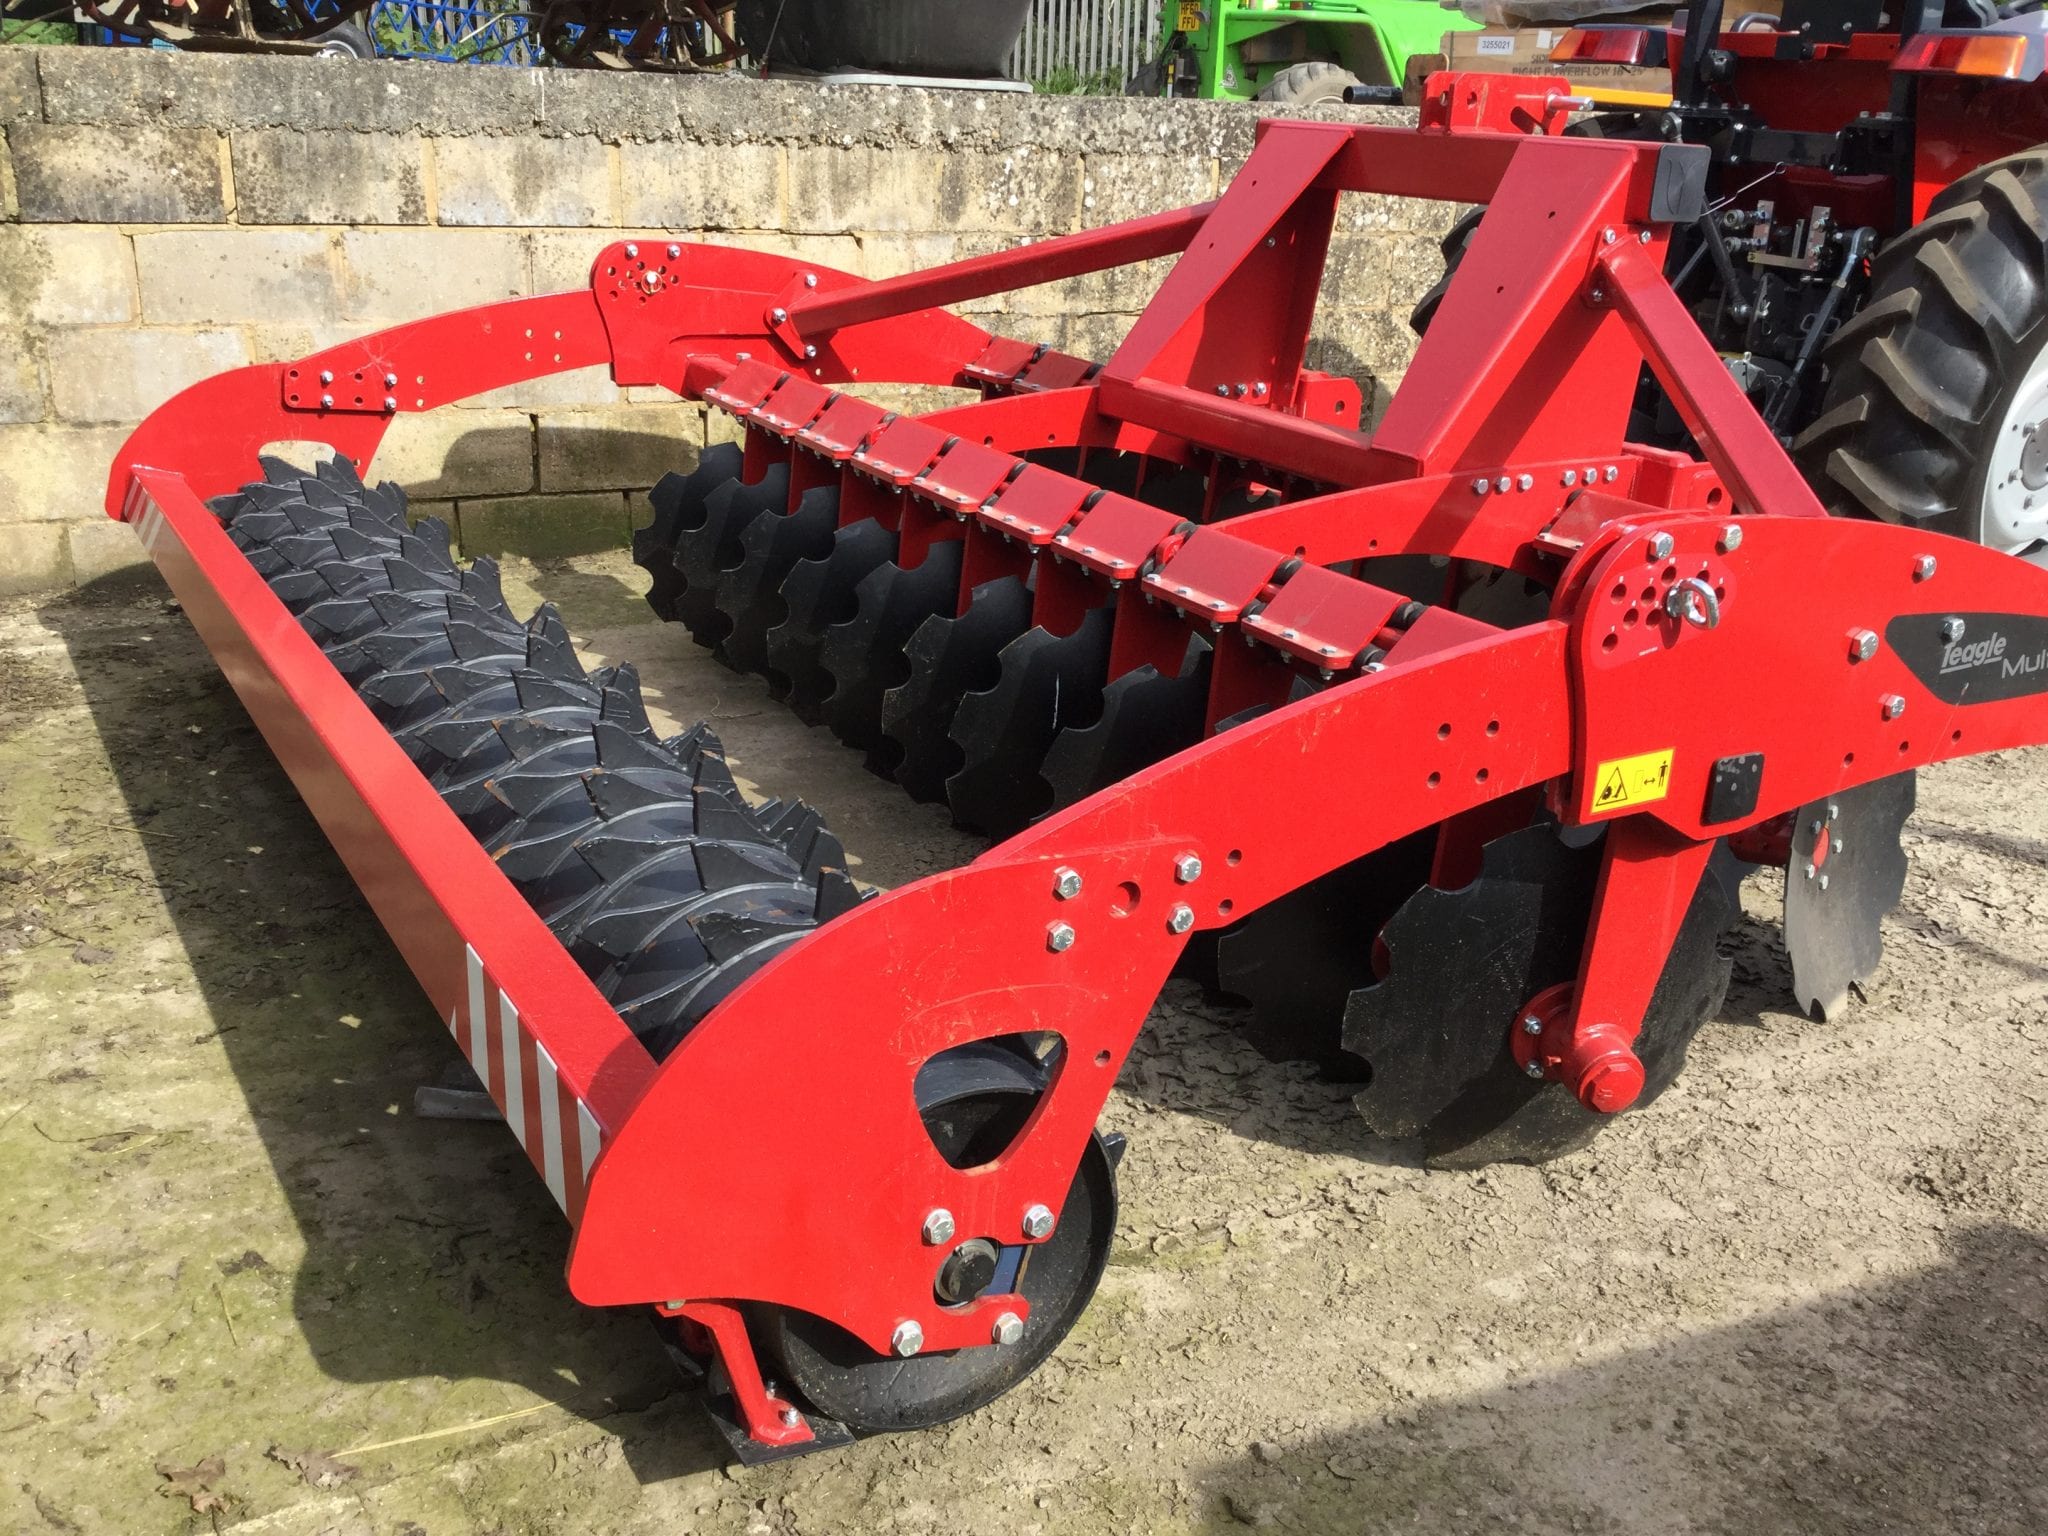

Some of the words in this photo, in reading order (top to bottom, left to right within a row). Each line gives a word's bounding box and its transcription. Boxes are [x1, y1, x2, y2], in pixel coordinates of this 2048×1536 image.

[1482, 40, 1510, 49] 3255021
[1940, 632, 2007, 669] Teagle
[2001, 649, 2048, 679] Mul
